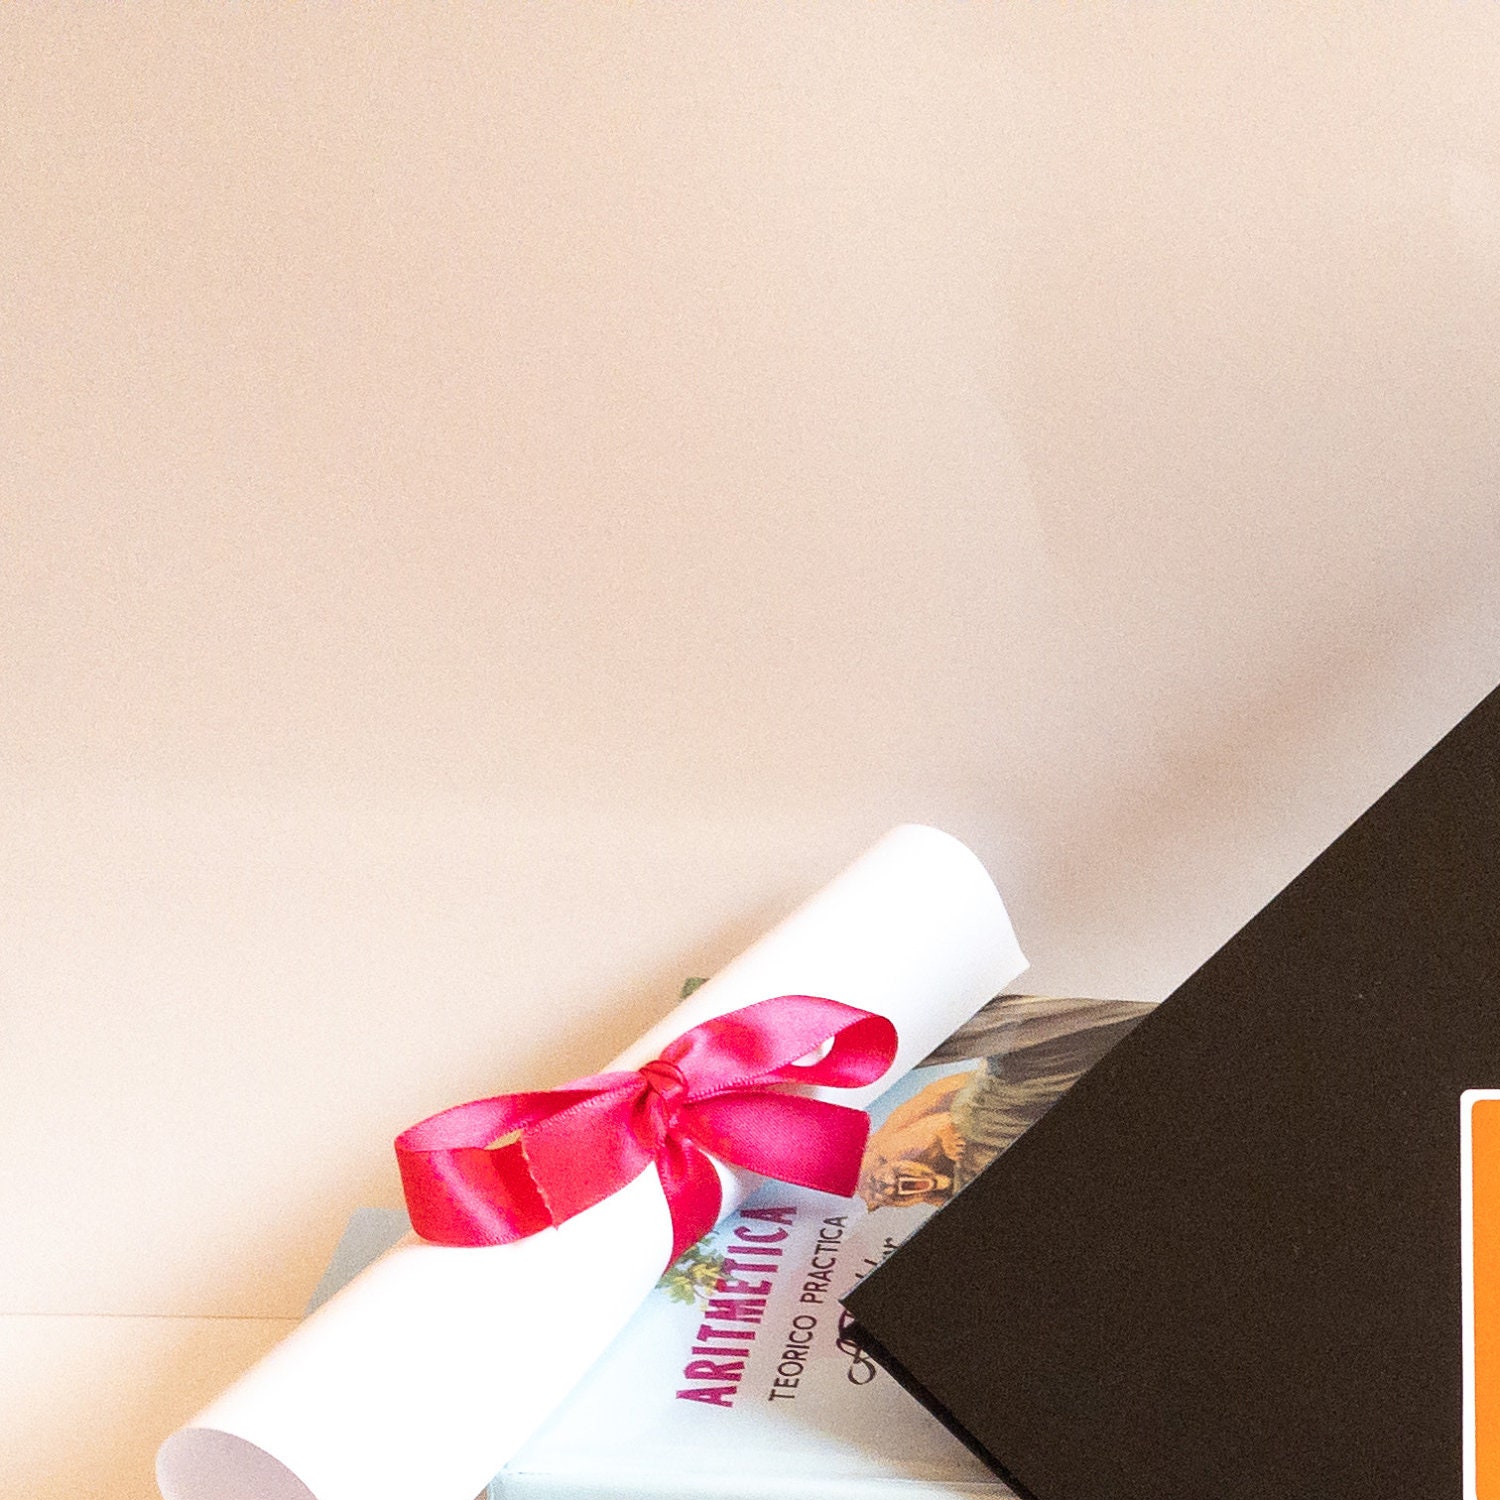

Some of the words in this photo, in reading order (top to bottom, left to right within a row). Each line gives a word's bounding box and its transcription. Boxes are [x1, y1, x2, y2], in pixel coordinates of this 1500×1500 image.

[676, 1206, 797, 1408] ARITMETICA
[768, 1314, 817, 1401] TEORICO
[801, 1215, 848, 1303] PRACTICA
